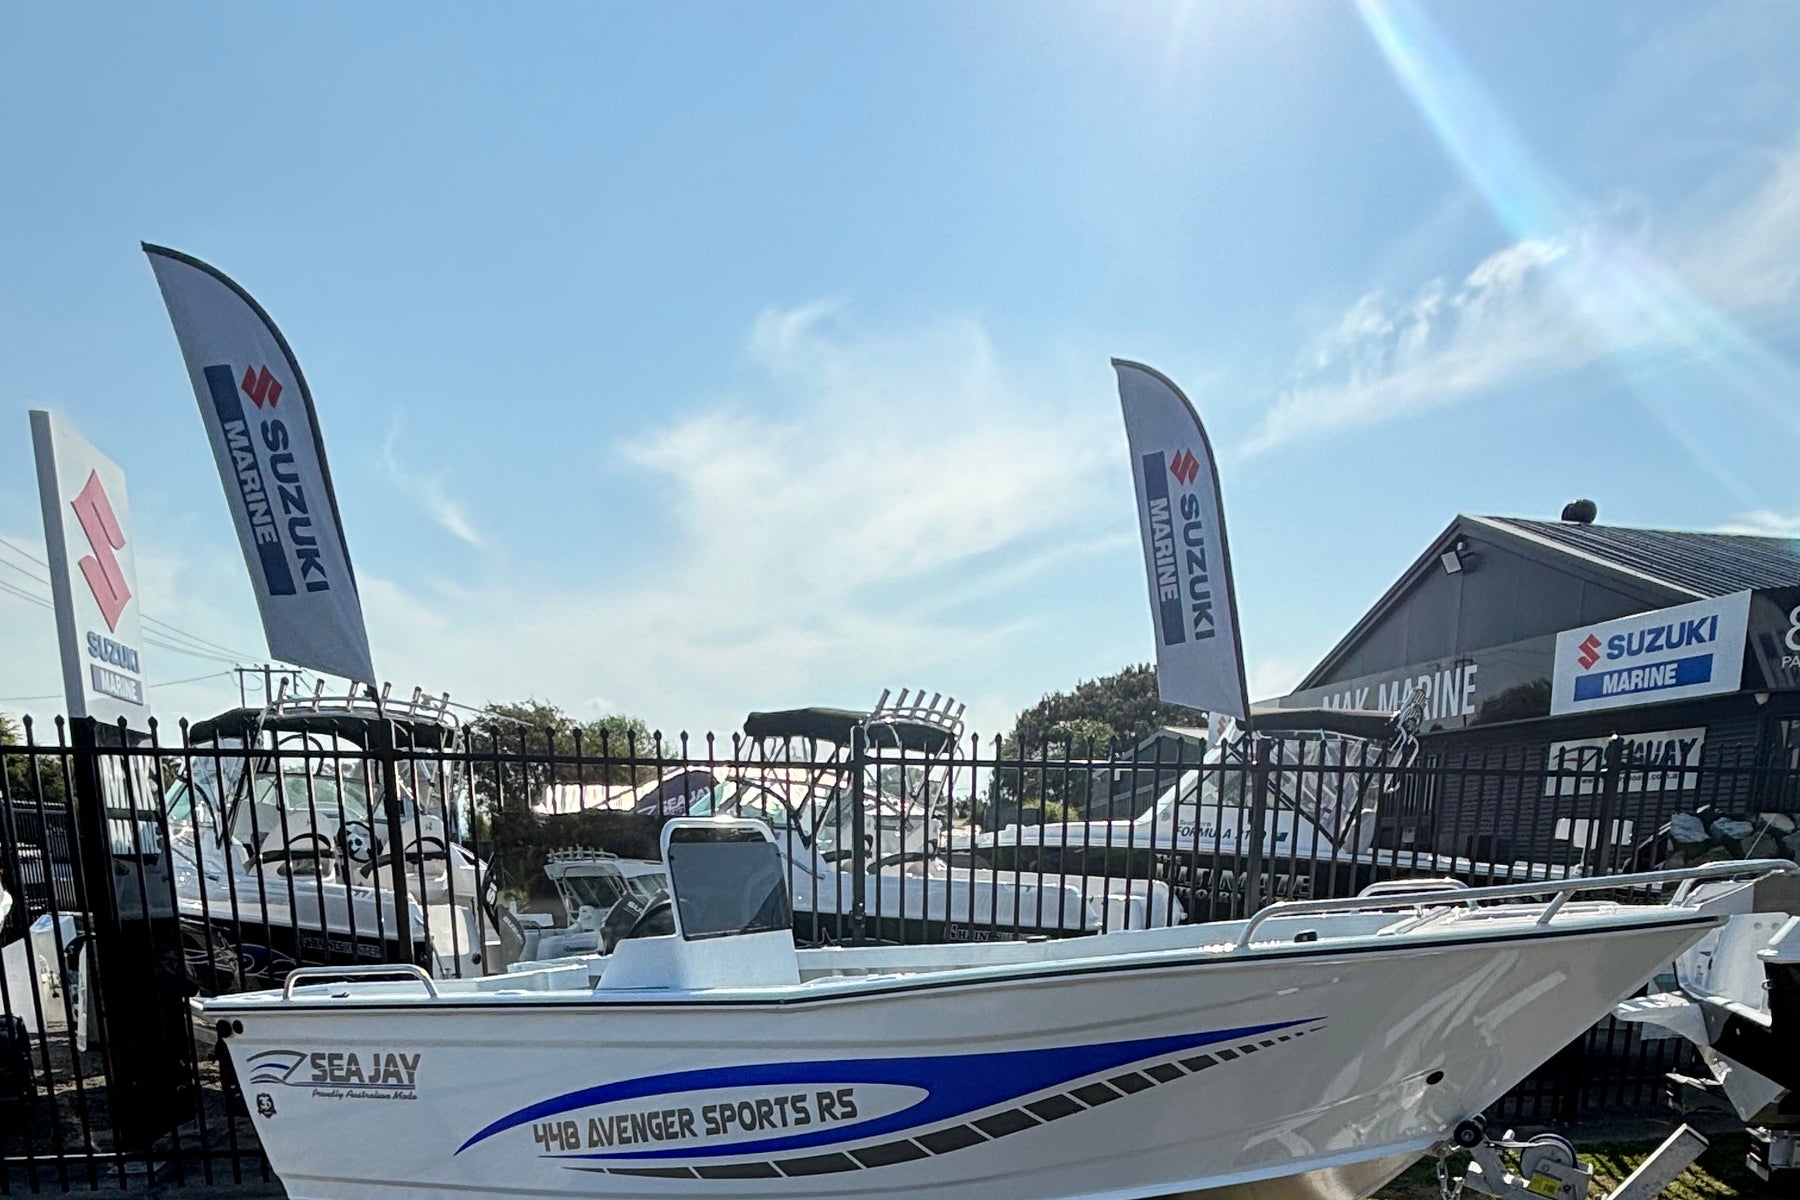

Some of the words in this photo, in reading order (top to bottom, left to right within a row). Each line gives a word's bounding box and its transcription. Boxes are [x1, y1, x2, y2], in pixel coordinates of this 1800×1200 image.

[224, 419, 278, 545] MARINE
[261, 419, 330, 592] SUZUKI
[1150, 498, 1178, 602] MARINE
[1181, 493, 1215, 640] SUZUKI
[87, 631, 140, 674] SUZUKI
[1606, 614, 1719, 660] SUZUKI
[101, 669, 138, 701] MARINE
[1602, 663, 1679, 695] MARINE
[1176, 826, 1231, 840] FORMUA
[346, 1089, 391, 1100] Australian
[533, 1120, 581, 1152] 448
[588, 1107, 698, 1148] AVENGER
[702, 1094, 811, 1136] SPORTS
[816, 1088, 858, 1122] RS
